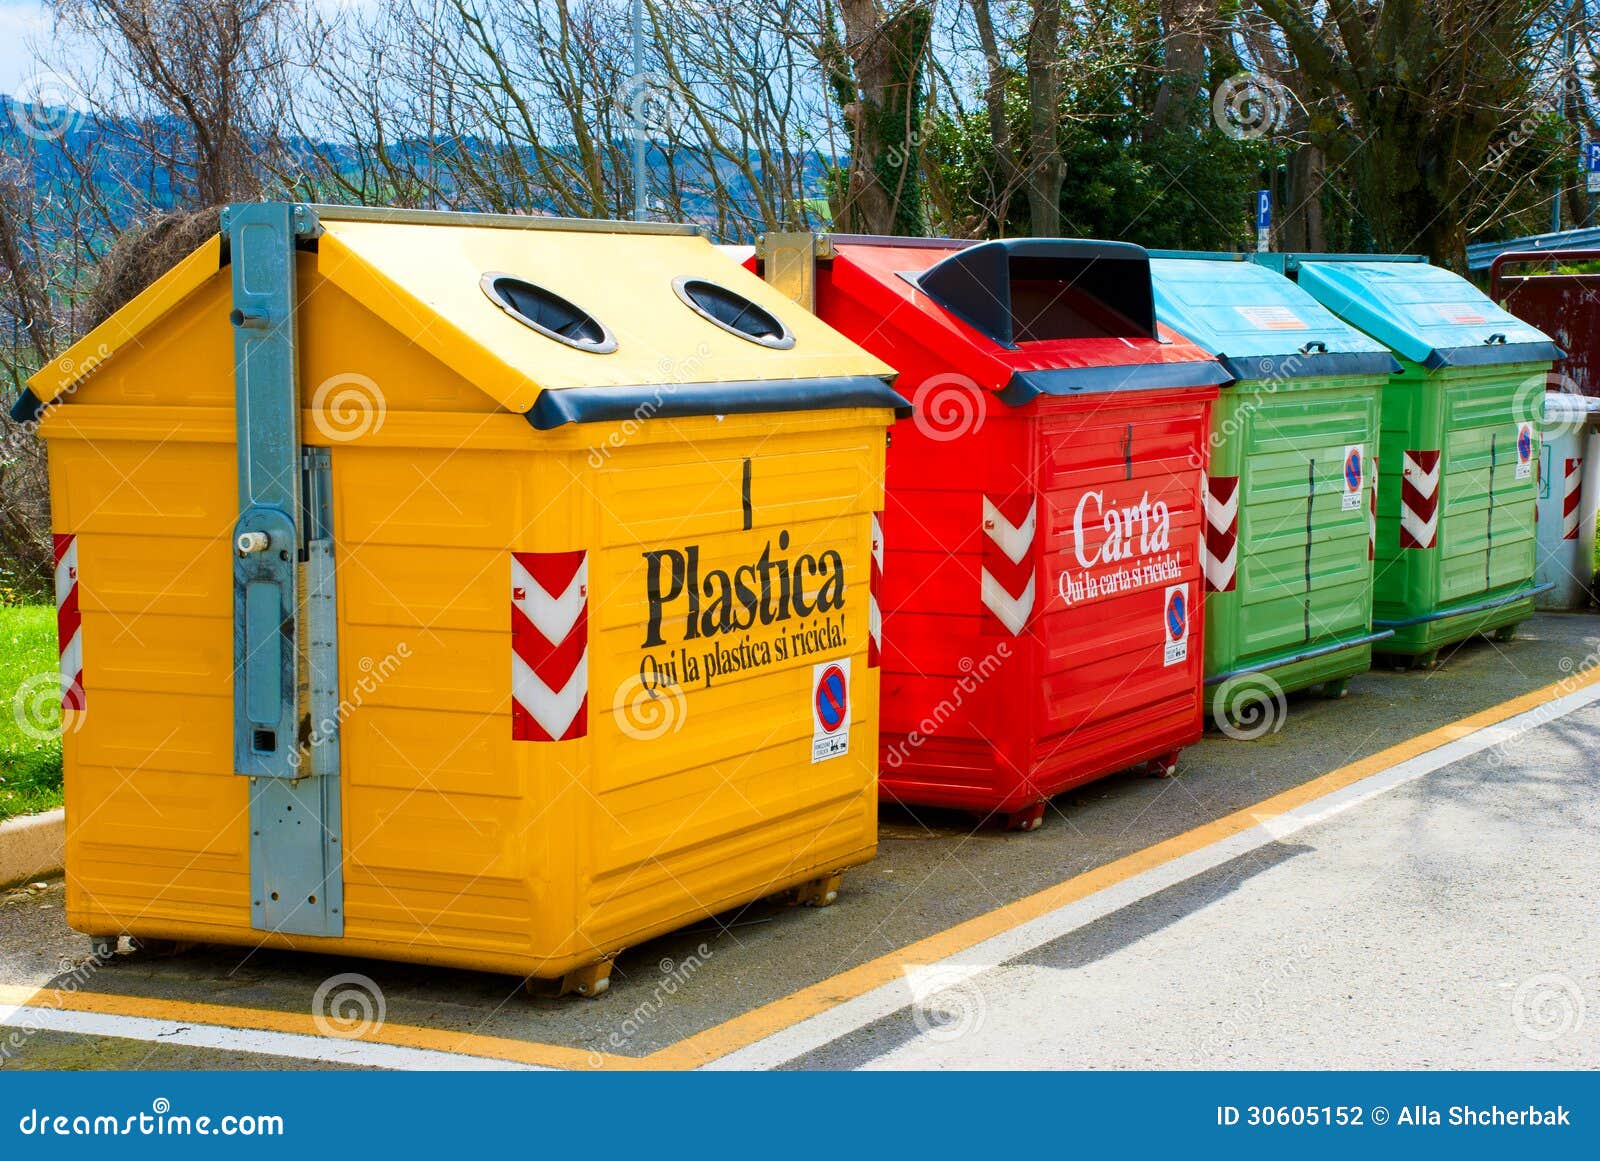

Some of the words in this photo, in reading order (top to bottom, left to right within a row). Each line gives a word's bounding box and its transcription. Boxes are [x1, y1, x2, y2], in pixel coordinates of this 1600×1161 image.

[1261, 194, 1269, 224] P
[1073, 490, 1170, 568] Carta
[641, 530, 846, 649] Plastica
[1059, 570, 1085, 606] Qui
[1085, 571, 1099, 599] la
[1100, 565, 1132, 596] carta
[1132, 559, 1142, 588] si
[1143, 551, 1182, 585] ricicla!
[640, 649, 680, 699] Qui
[682, 648, 701, 684] la
[703, 634, 772, 689] plastica
[774, 626, 789, 662] si
[791, 614, 848, 658] ricicla!
